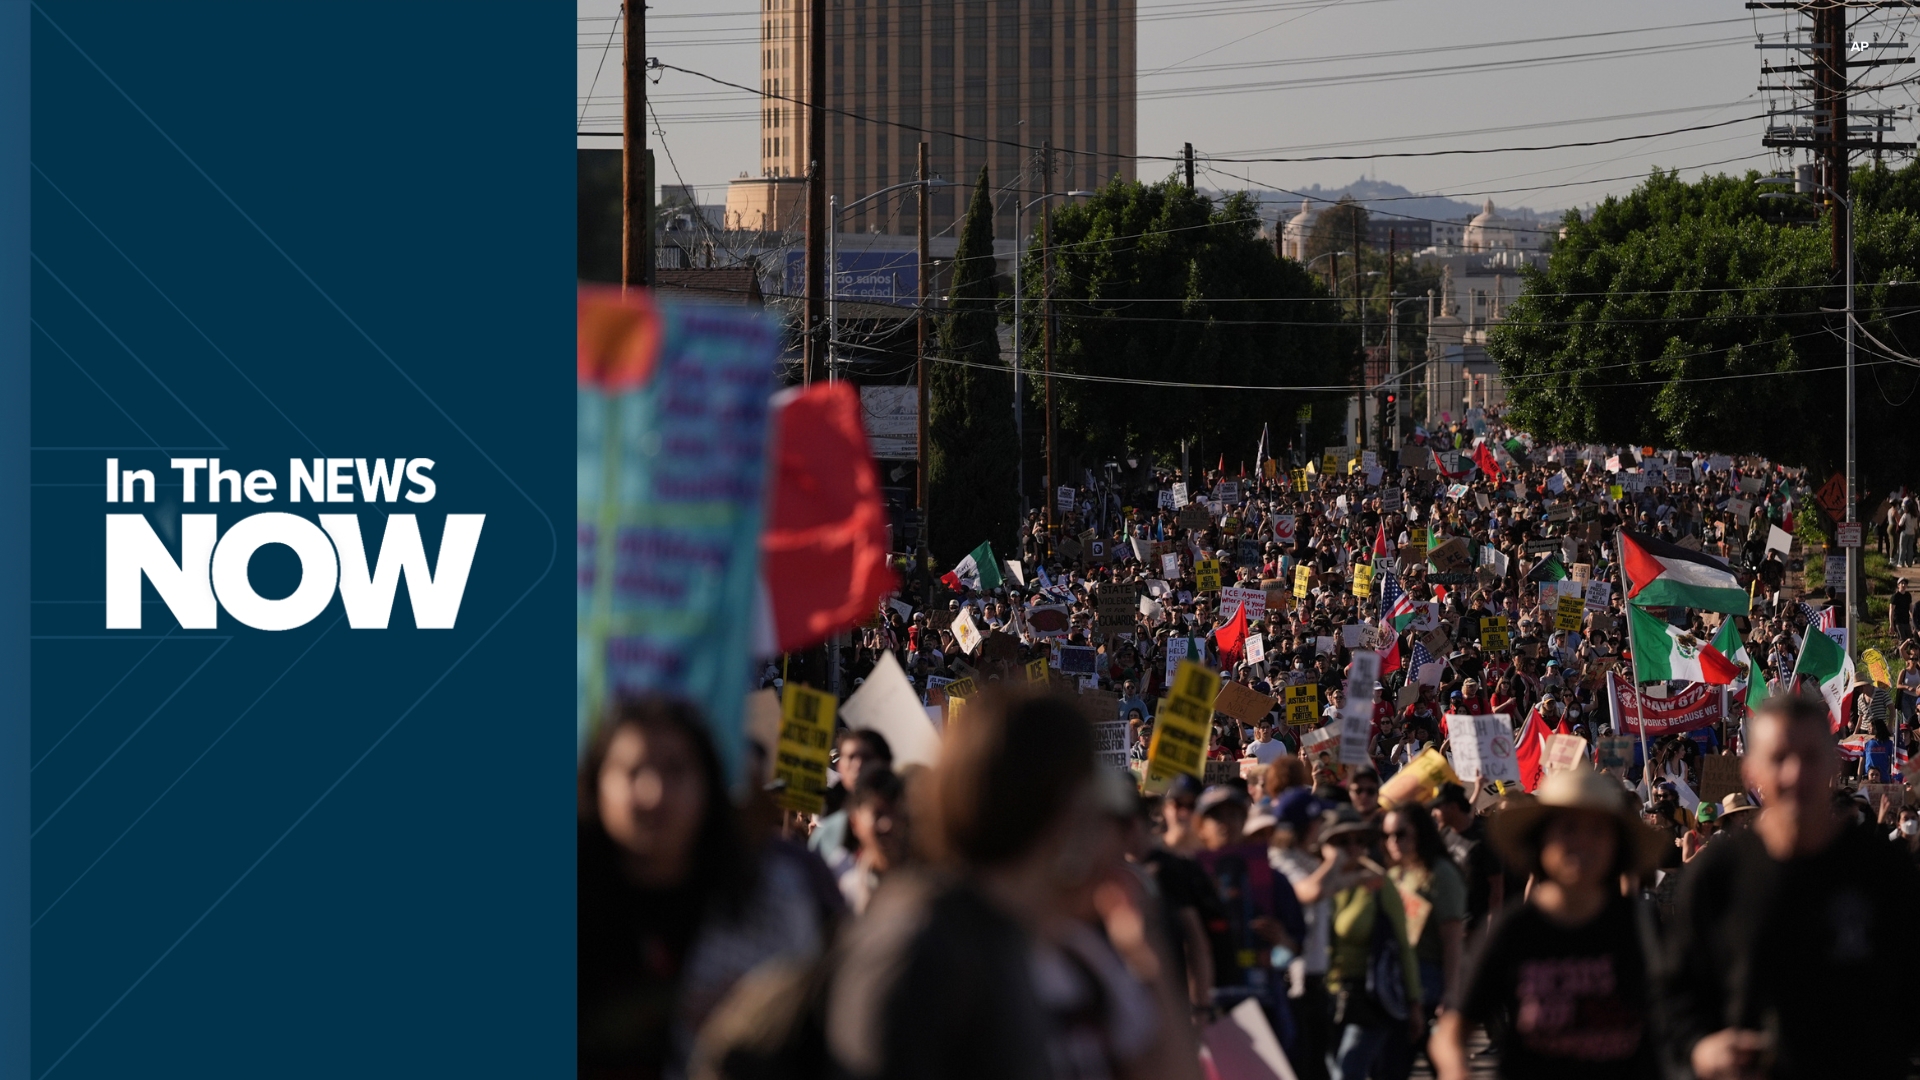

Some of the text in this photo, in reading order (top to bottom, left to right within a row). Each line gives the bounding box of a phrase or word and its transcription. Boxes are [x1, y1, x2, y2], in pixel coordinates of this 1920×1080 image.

[856, 275, 891, 285] sanos
[1625, 482, 1640, 491] ALL
[1432, 549, 1445, 559] NO
[1374, 559, 1394, 569] ICE
[1101, 584, 1132, 595] STATE
[1562, 582, 1575, 590] NO
[1224, 589, 1265, 600] ICE Agents
[1100, 596, 1134, 605] VIOLENCE
[1100, 614, 1136, 627] COWARDS
[1362, 627, 1375, 636] FUCK
[1030, 660, 1043, 680] ICE
[948, 678, 974, 697] STOP
[1287, 696, 1306, 705] JUSTICE
[1641, 686, 1706, 712] UAW 872
[1625, 704, 1719, 727] USC WORKS BECAUSE WE
[1111, 739, 1124, 750] FOR
[1217, 764, 1231, 772] MY
